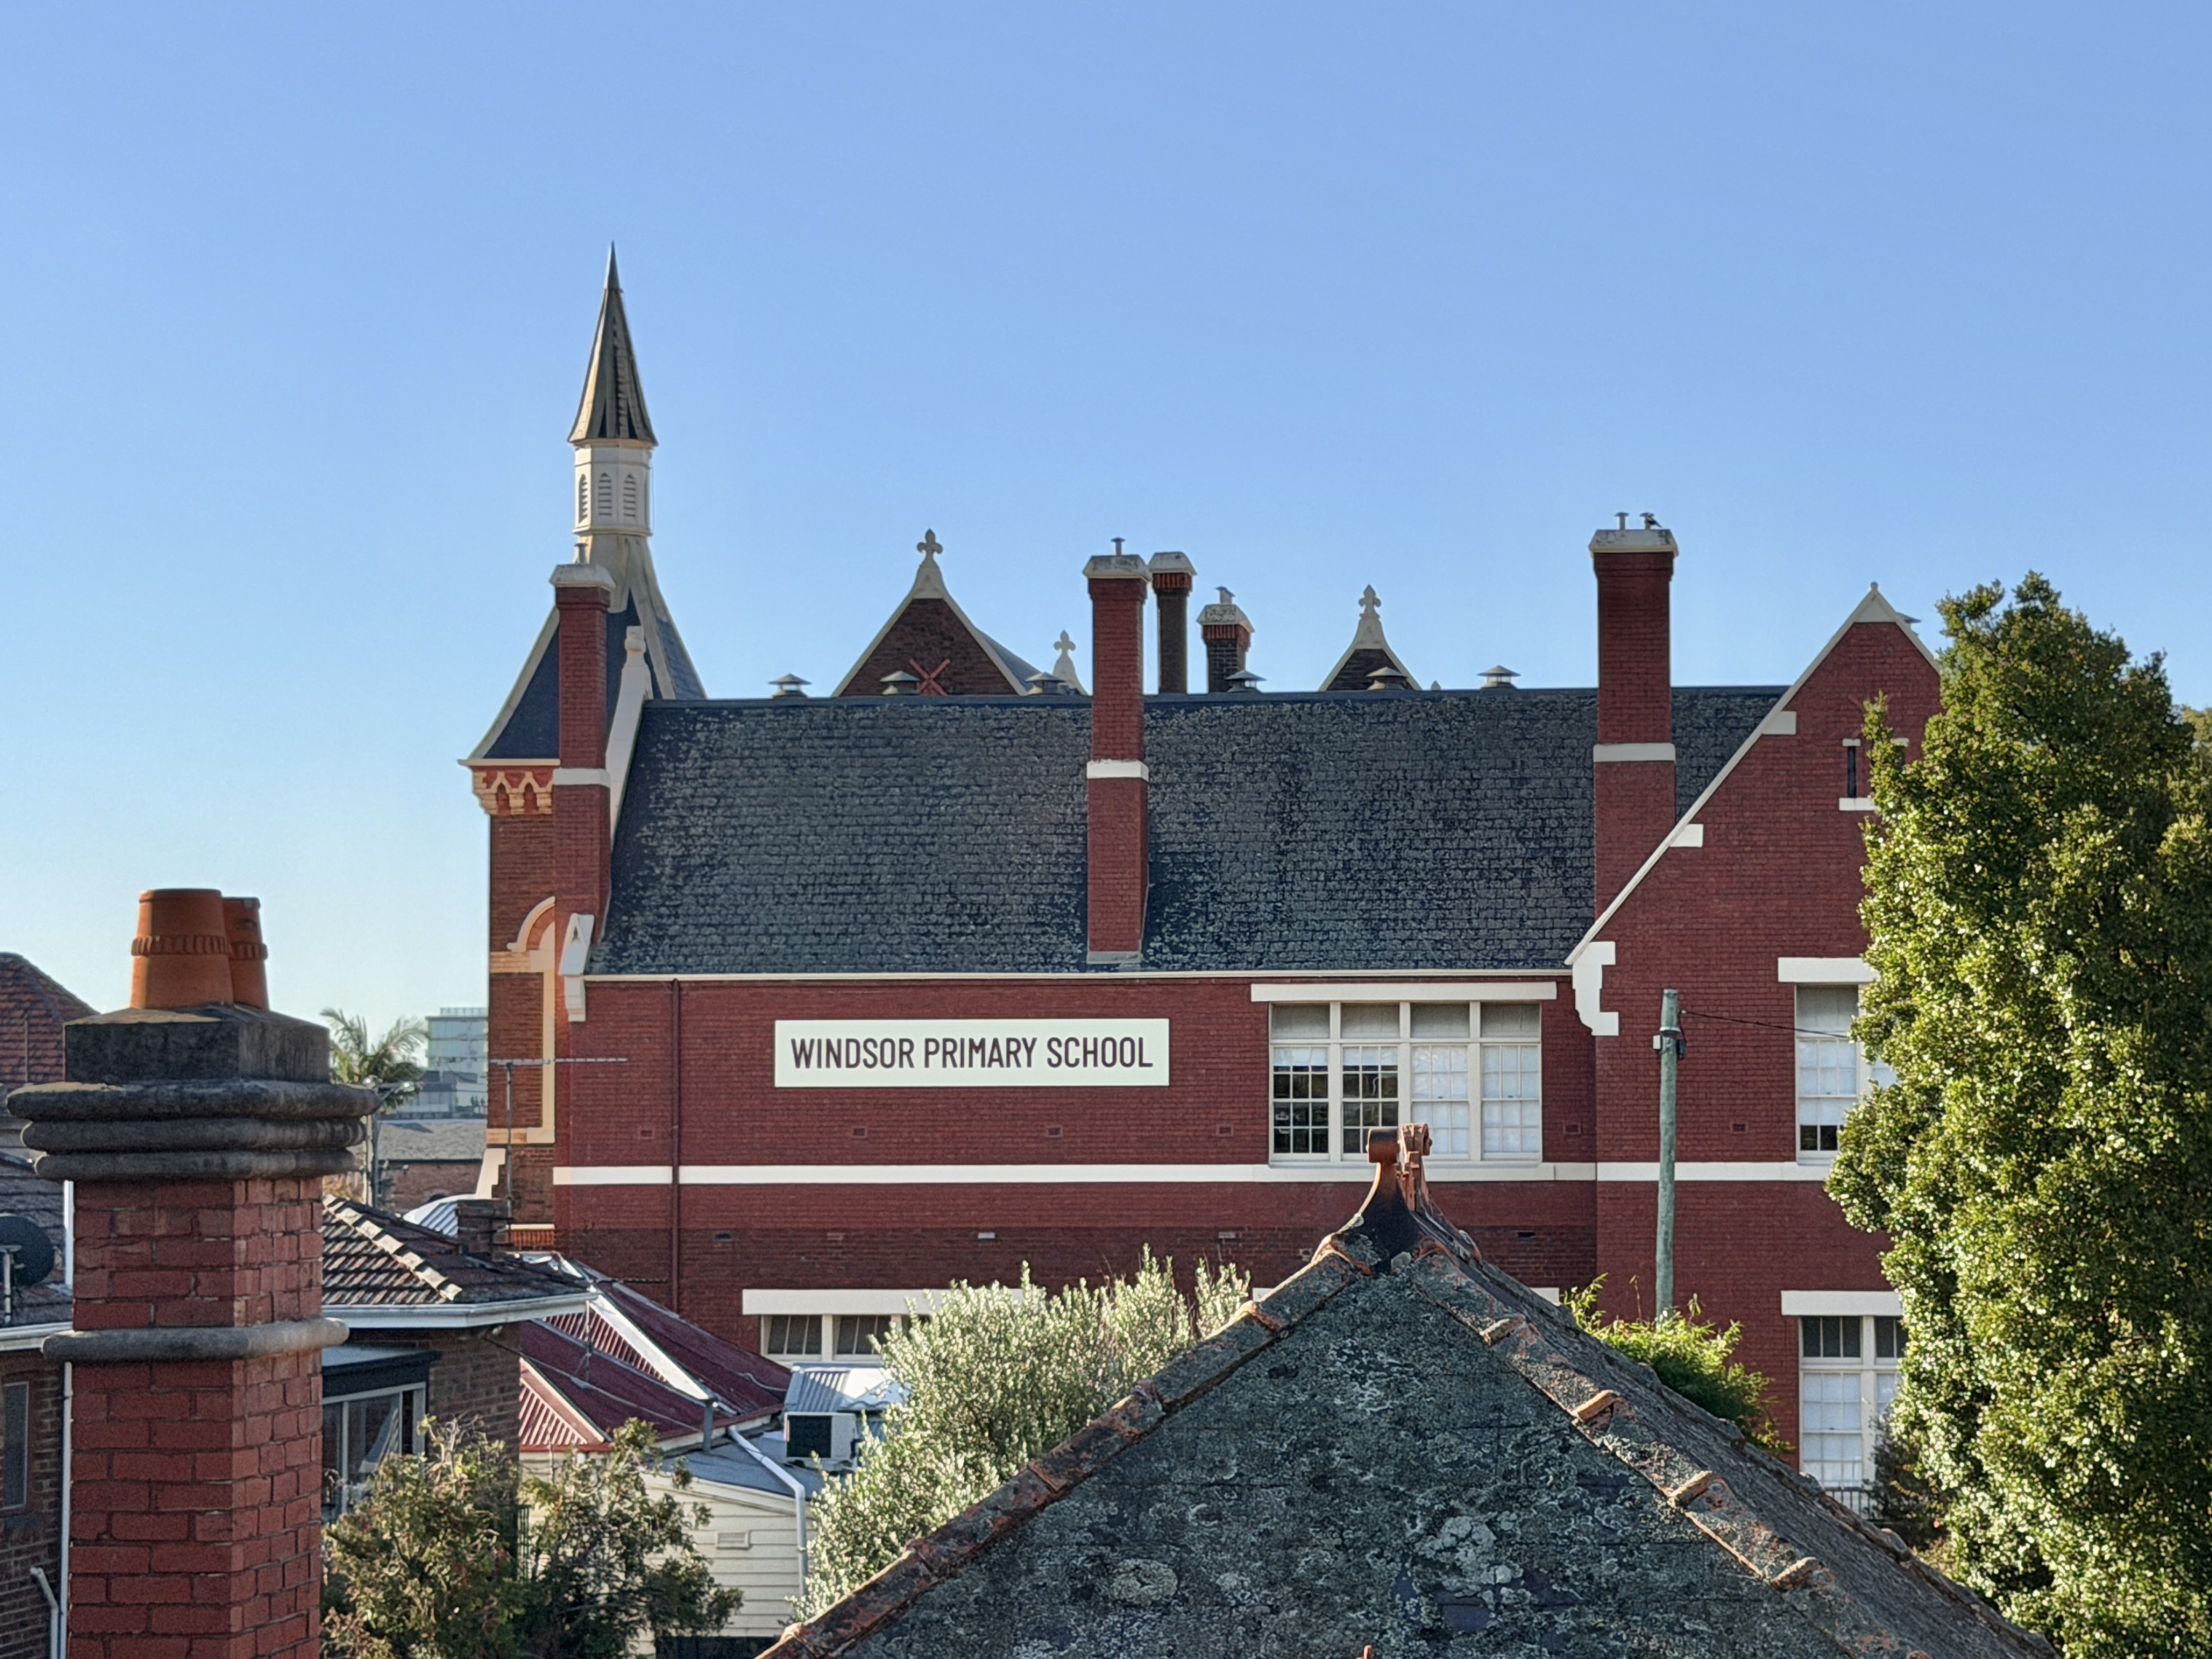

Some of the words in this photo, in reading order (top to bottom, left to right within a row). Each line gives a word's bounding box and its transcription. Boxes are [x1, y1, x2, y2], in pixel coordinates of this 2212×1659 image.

[791, 1038, 914, 1069] WINDSOR
[924, 1037, 1038, 1069] PRIMARY
[1047, 1036, 1153, 1068] SCHOOL
